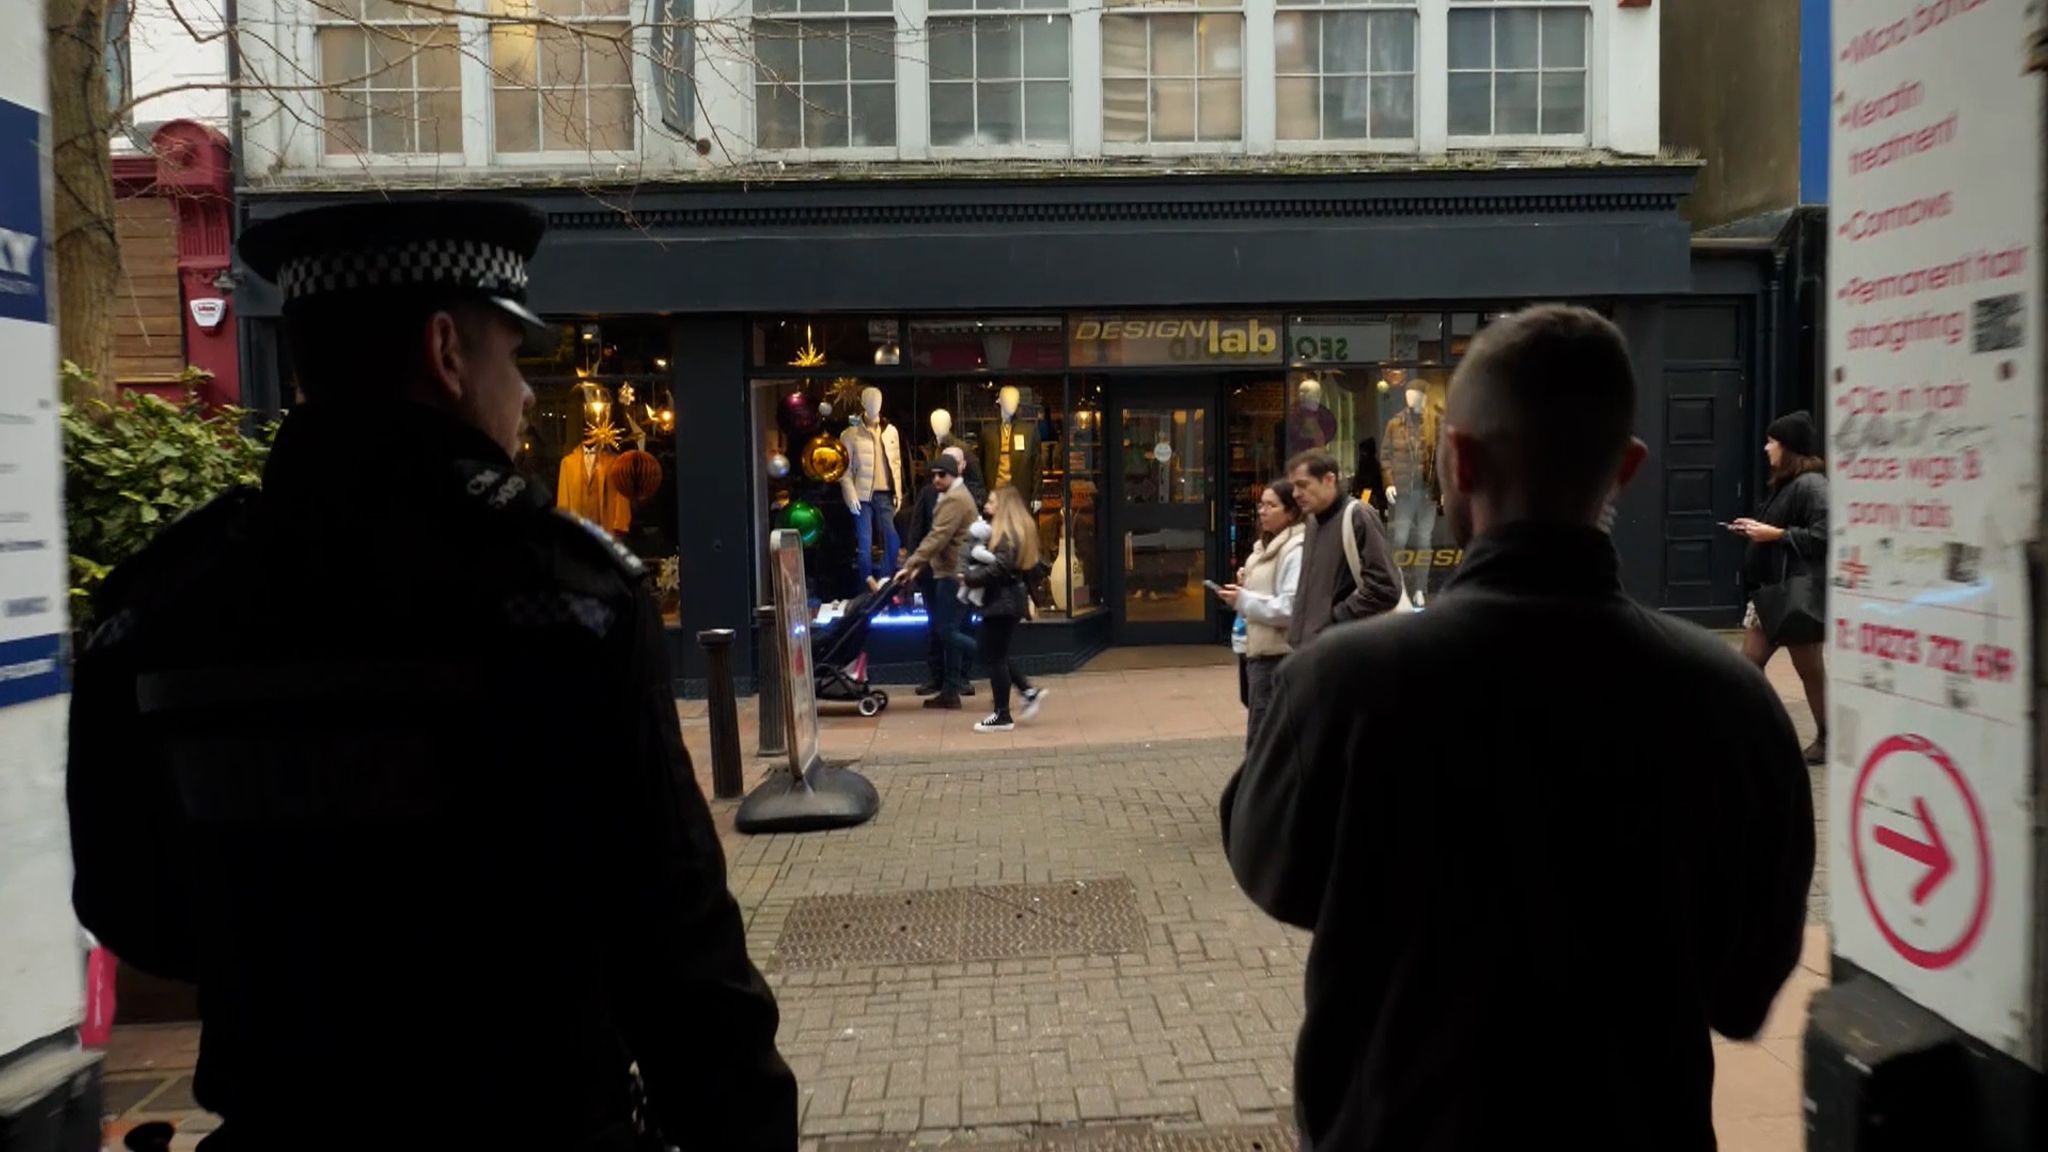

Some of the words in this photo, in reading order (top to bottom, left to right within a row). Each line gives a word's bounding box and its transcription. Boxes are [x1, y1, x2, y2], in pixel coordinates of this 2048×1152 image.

[1075, 320, 1208, 340] DESIGN
[1208, 319, 1276, 354] lab
[1391, 547, 1464, 568] DESI
